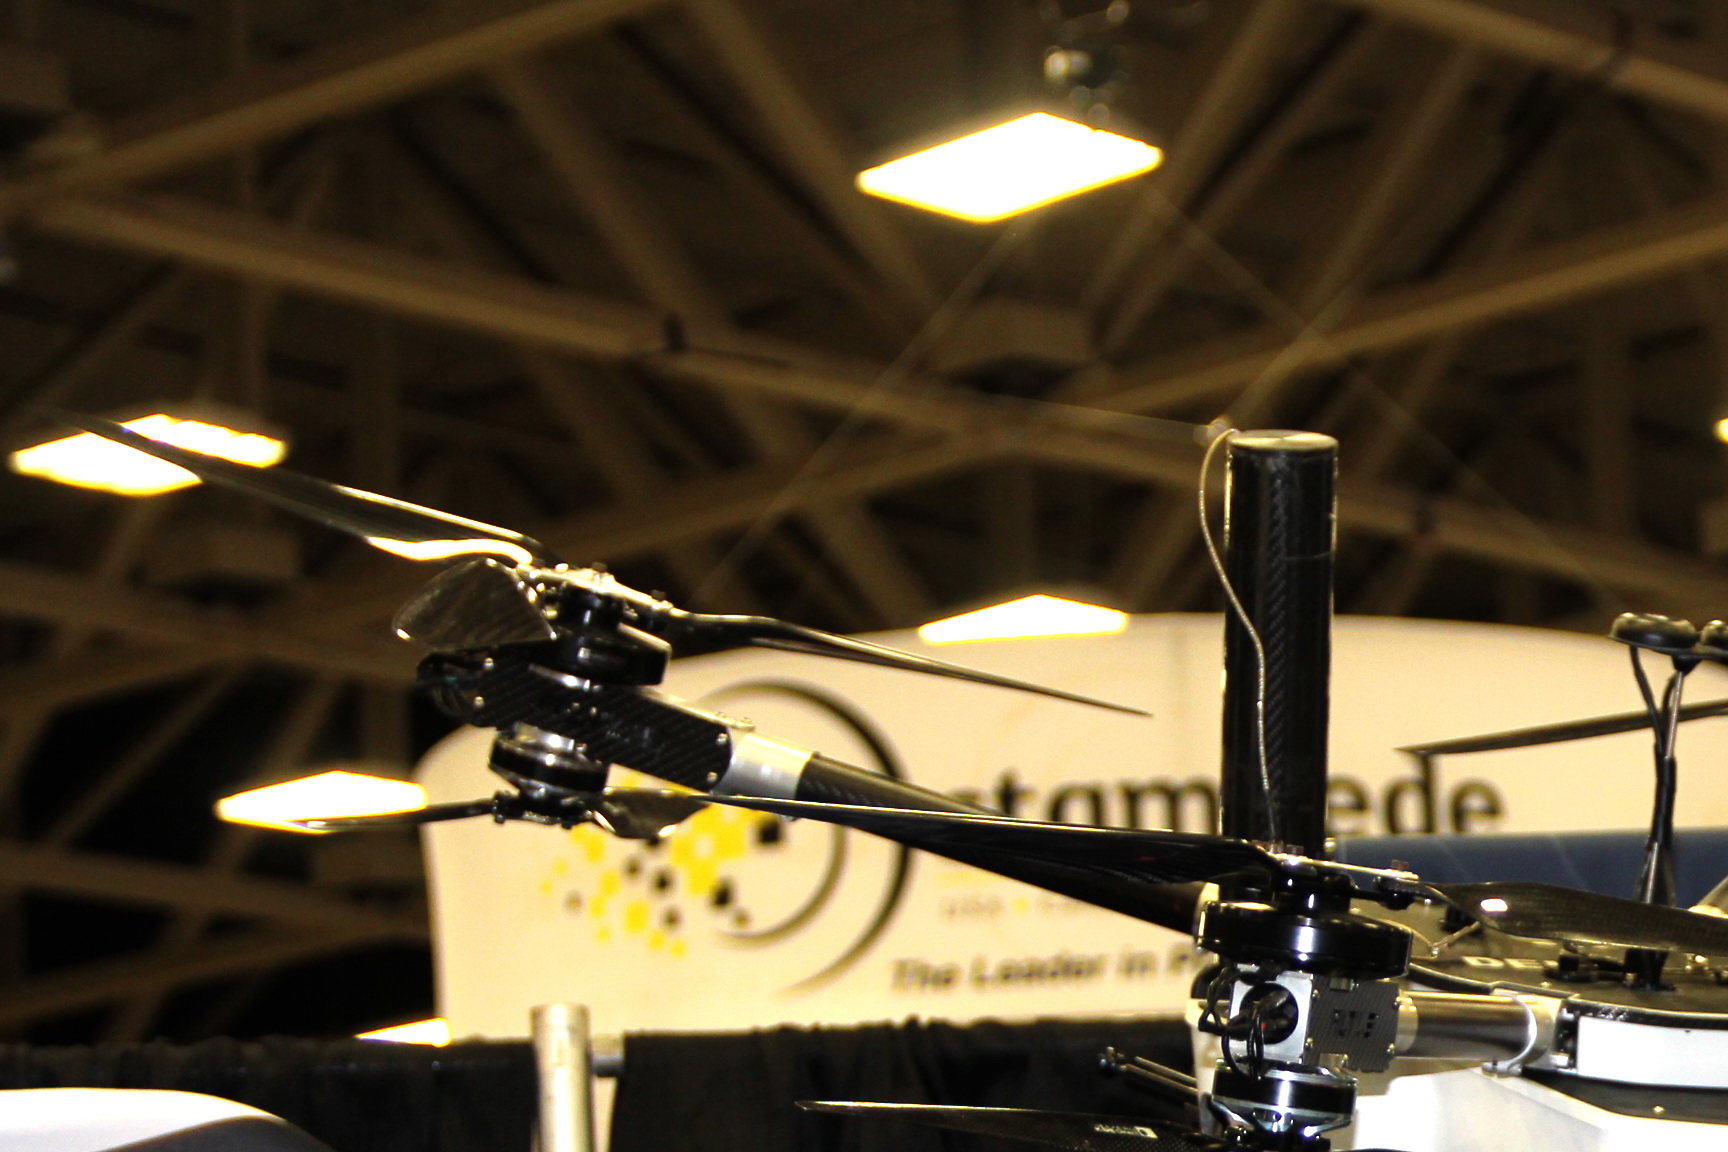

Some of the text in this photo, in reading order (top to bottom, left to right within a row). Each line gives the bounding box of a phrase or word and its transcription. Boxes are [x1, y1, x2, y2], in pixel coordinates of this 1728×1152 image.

[891, 957, 958, 992] The
[969, 953, 1107, 987] Leader
[1114, 946, 1155, 978] in
